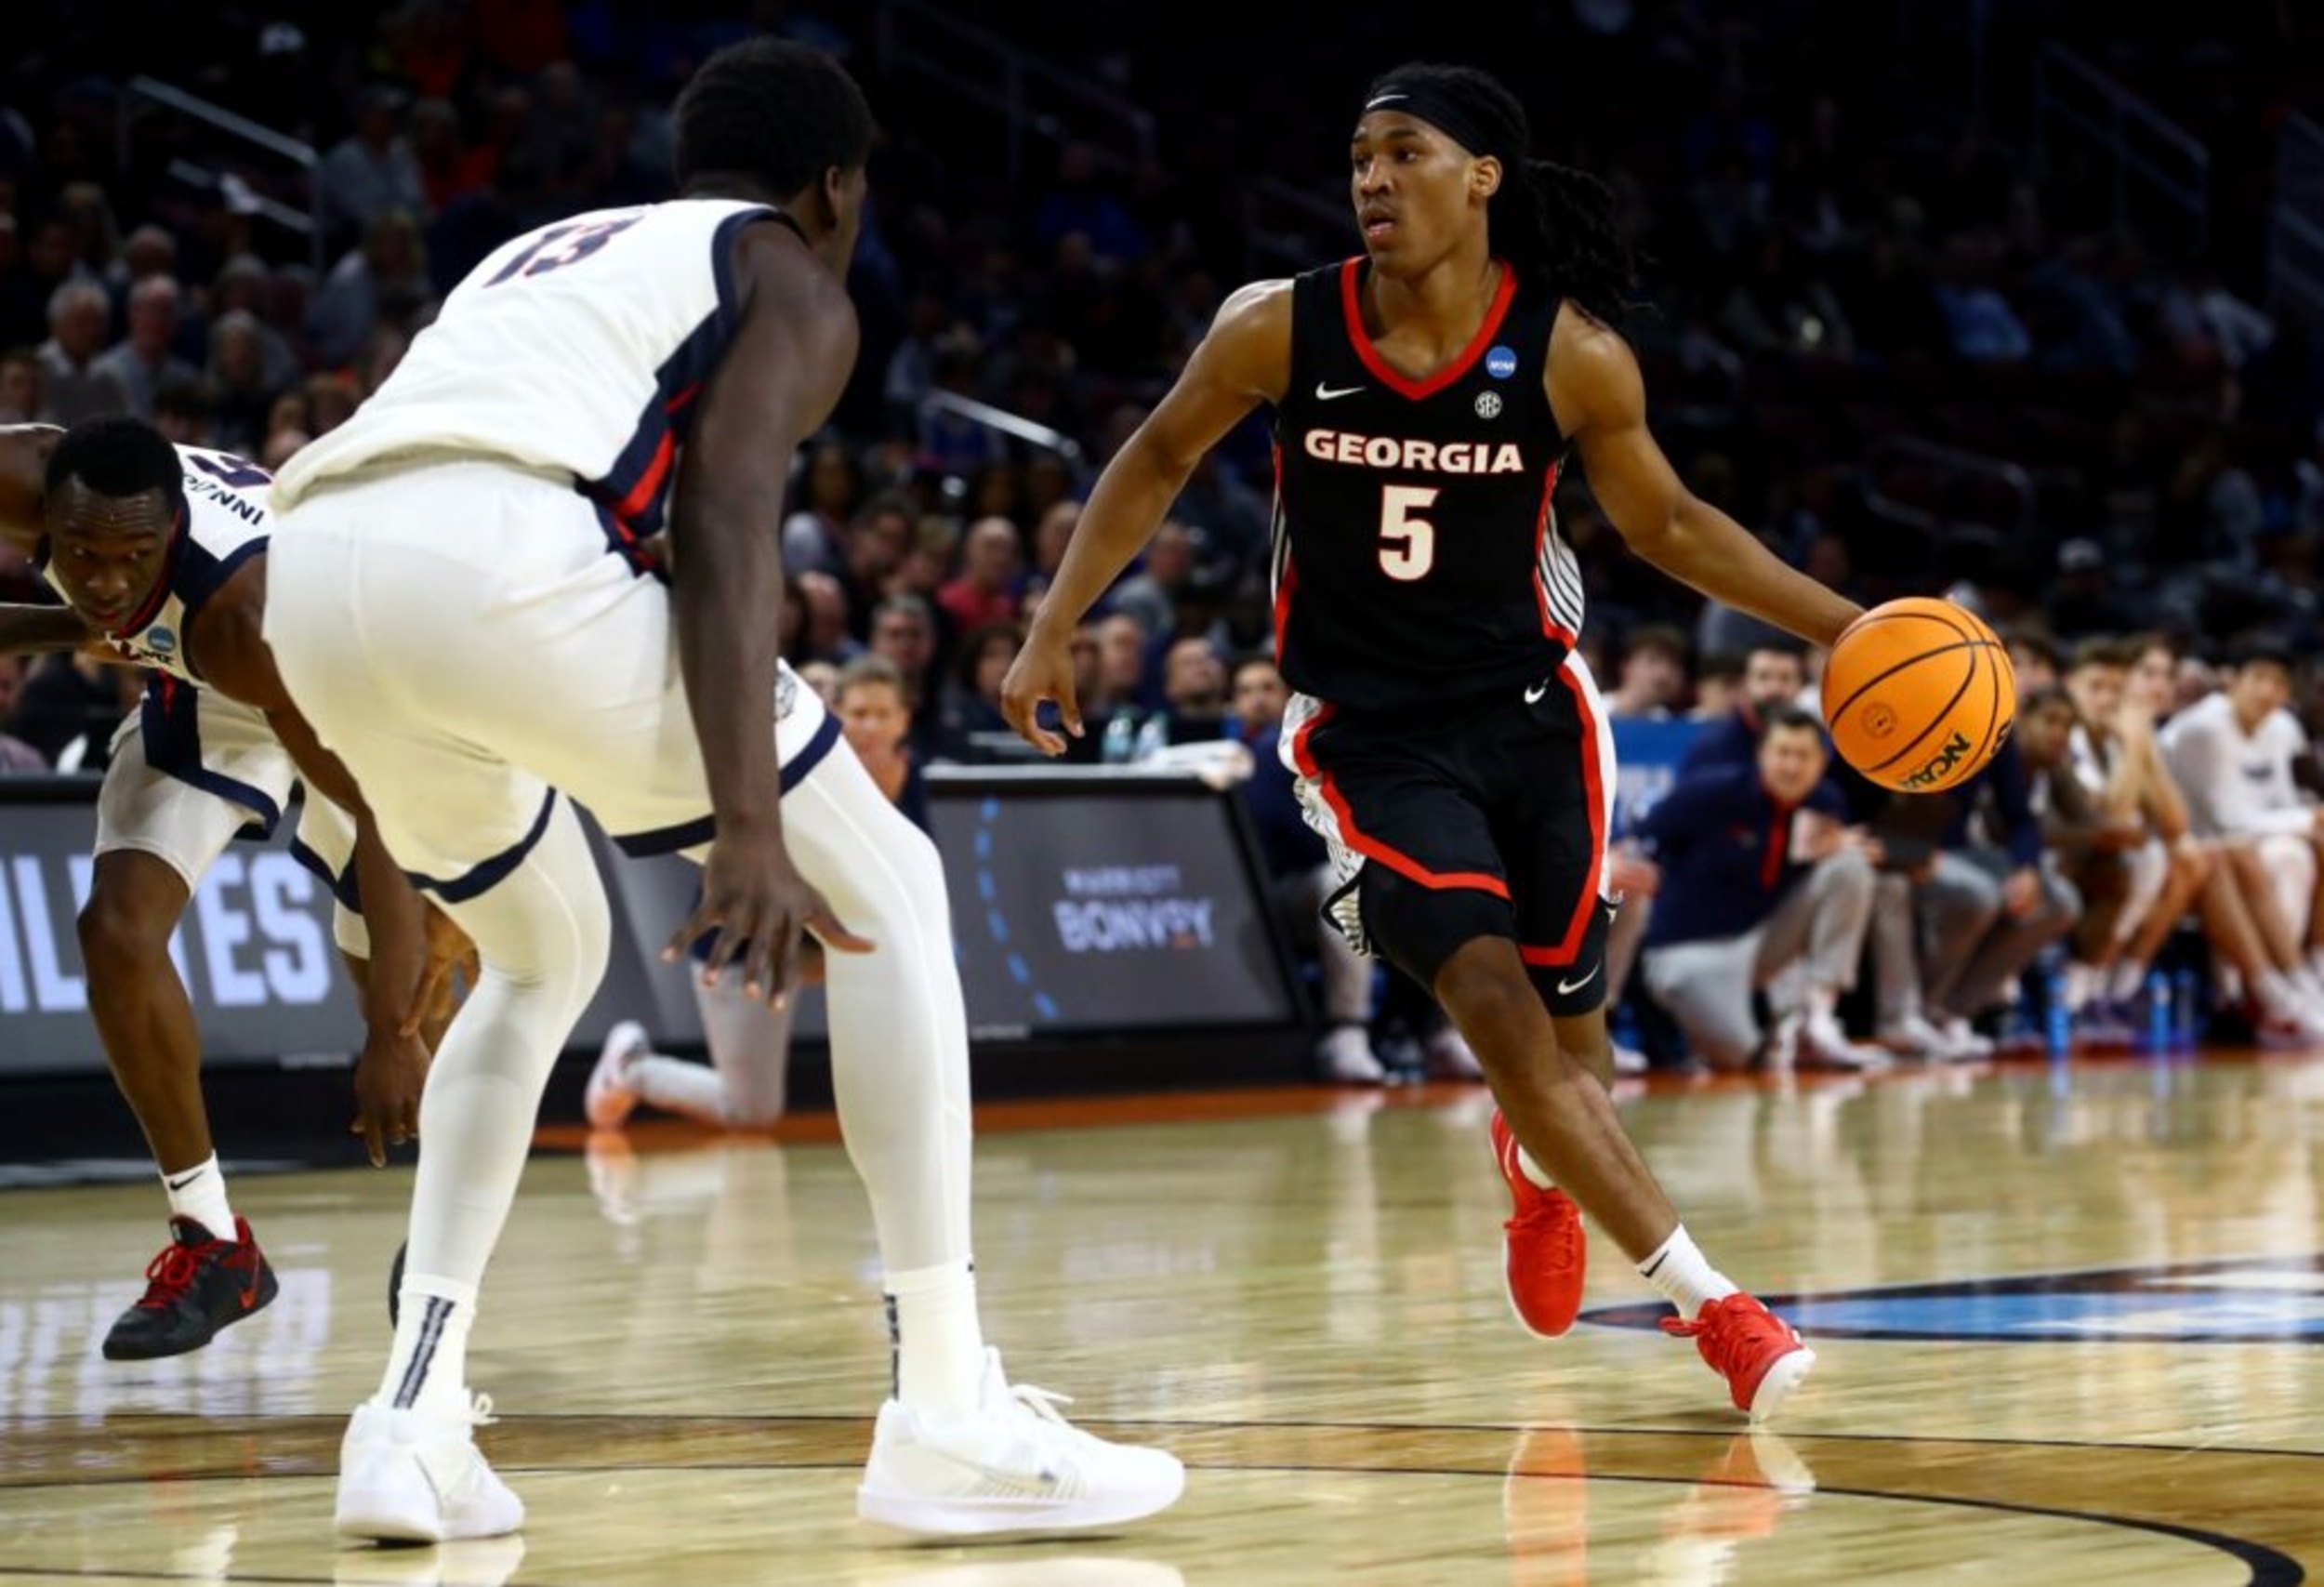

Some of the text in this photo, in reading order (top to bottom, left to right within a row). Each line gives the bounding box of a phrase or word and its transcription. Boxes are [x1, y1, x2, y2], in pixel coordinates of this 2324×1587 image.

[482, 218, 646, 287] 13
[1304, 429, 1525, 473] GEORGIA
[1379, 484, 1442, 581] 5
